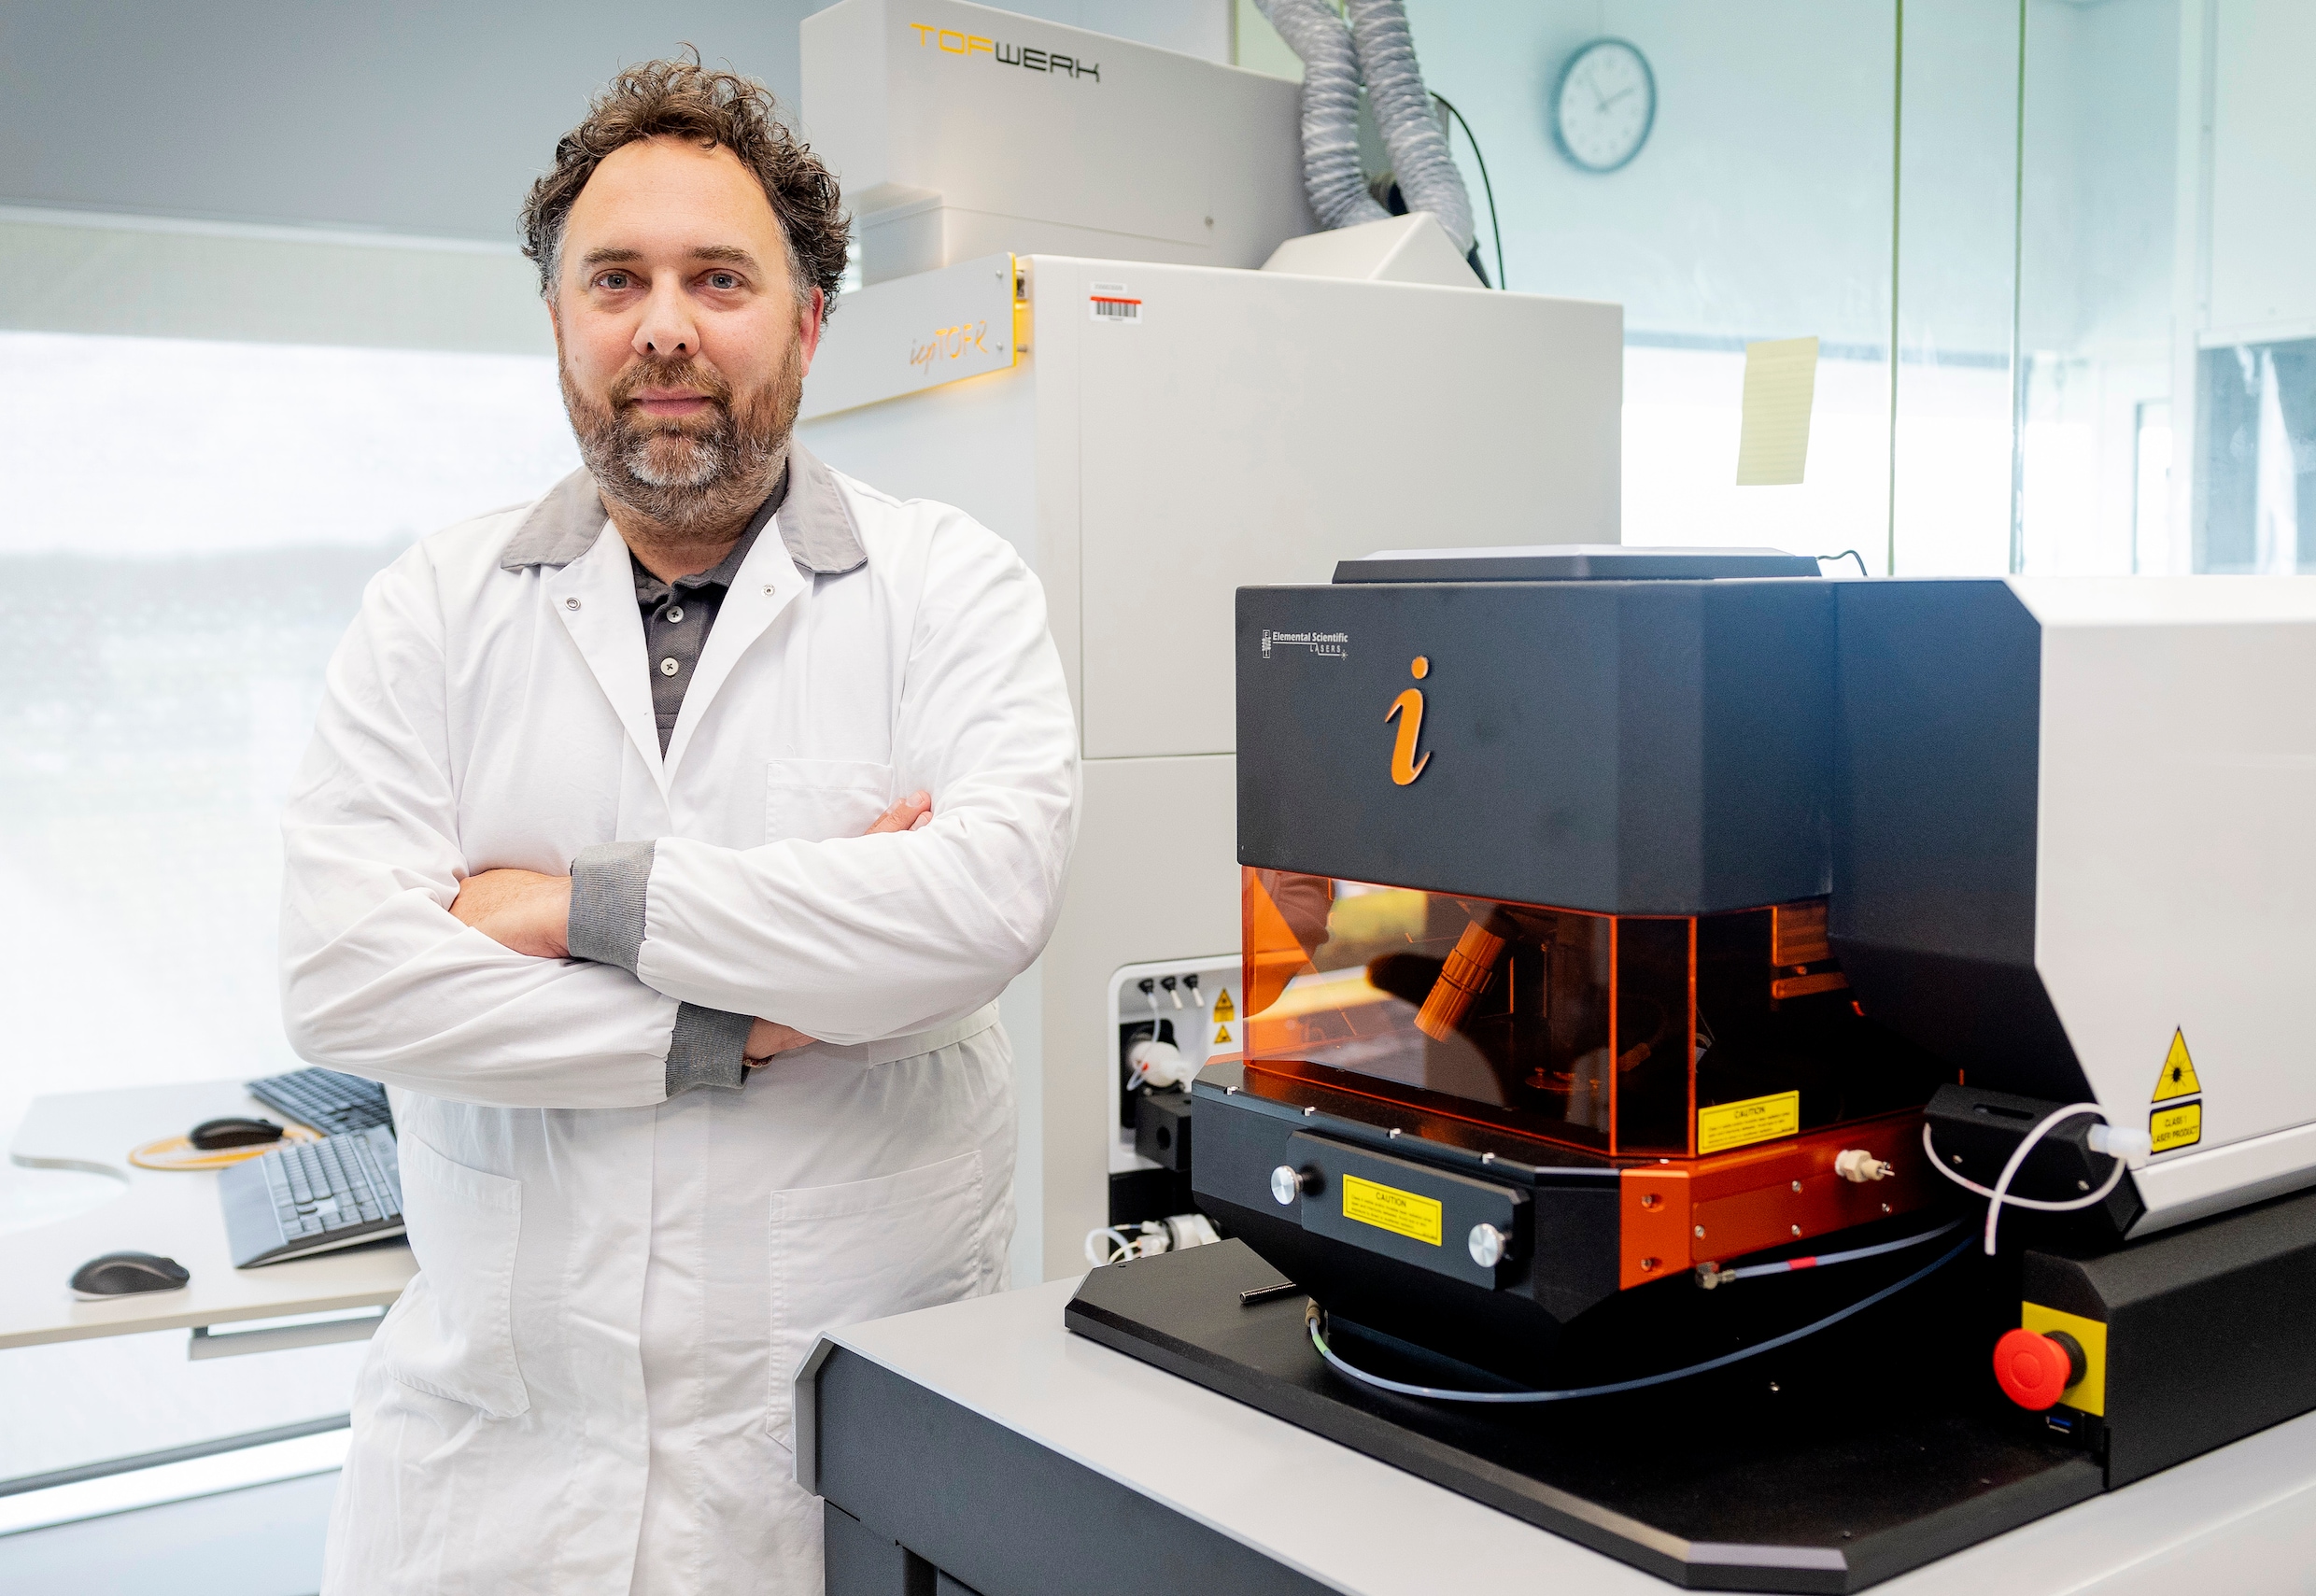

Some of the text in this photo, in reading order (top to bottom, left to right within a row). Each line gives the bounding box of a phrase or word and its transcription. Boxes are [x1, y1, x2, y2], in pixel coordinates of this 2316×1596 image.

[910, 21, 1100, 83] TOFWERK
[1272, 631, 1349, 643] Elemental Scientific
[1309, 644, 1341, 653] LASERS
[1384, 655, 1431, 786] i
[1376, 1192, 1407, 1208] CAUTION
